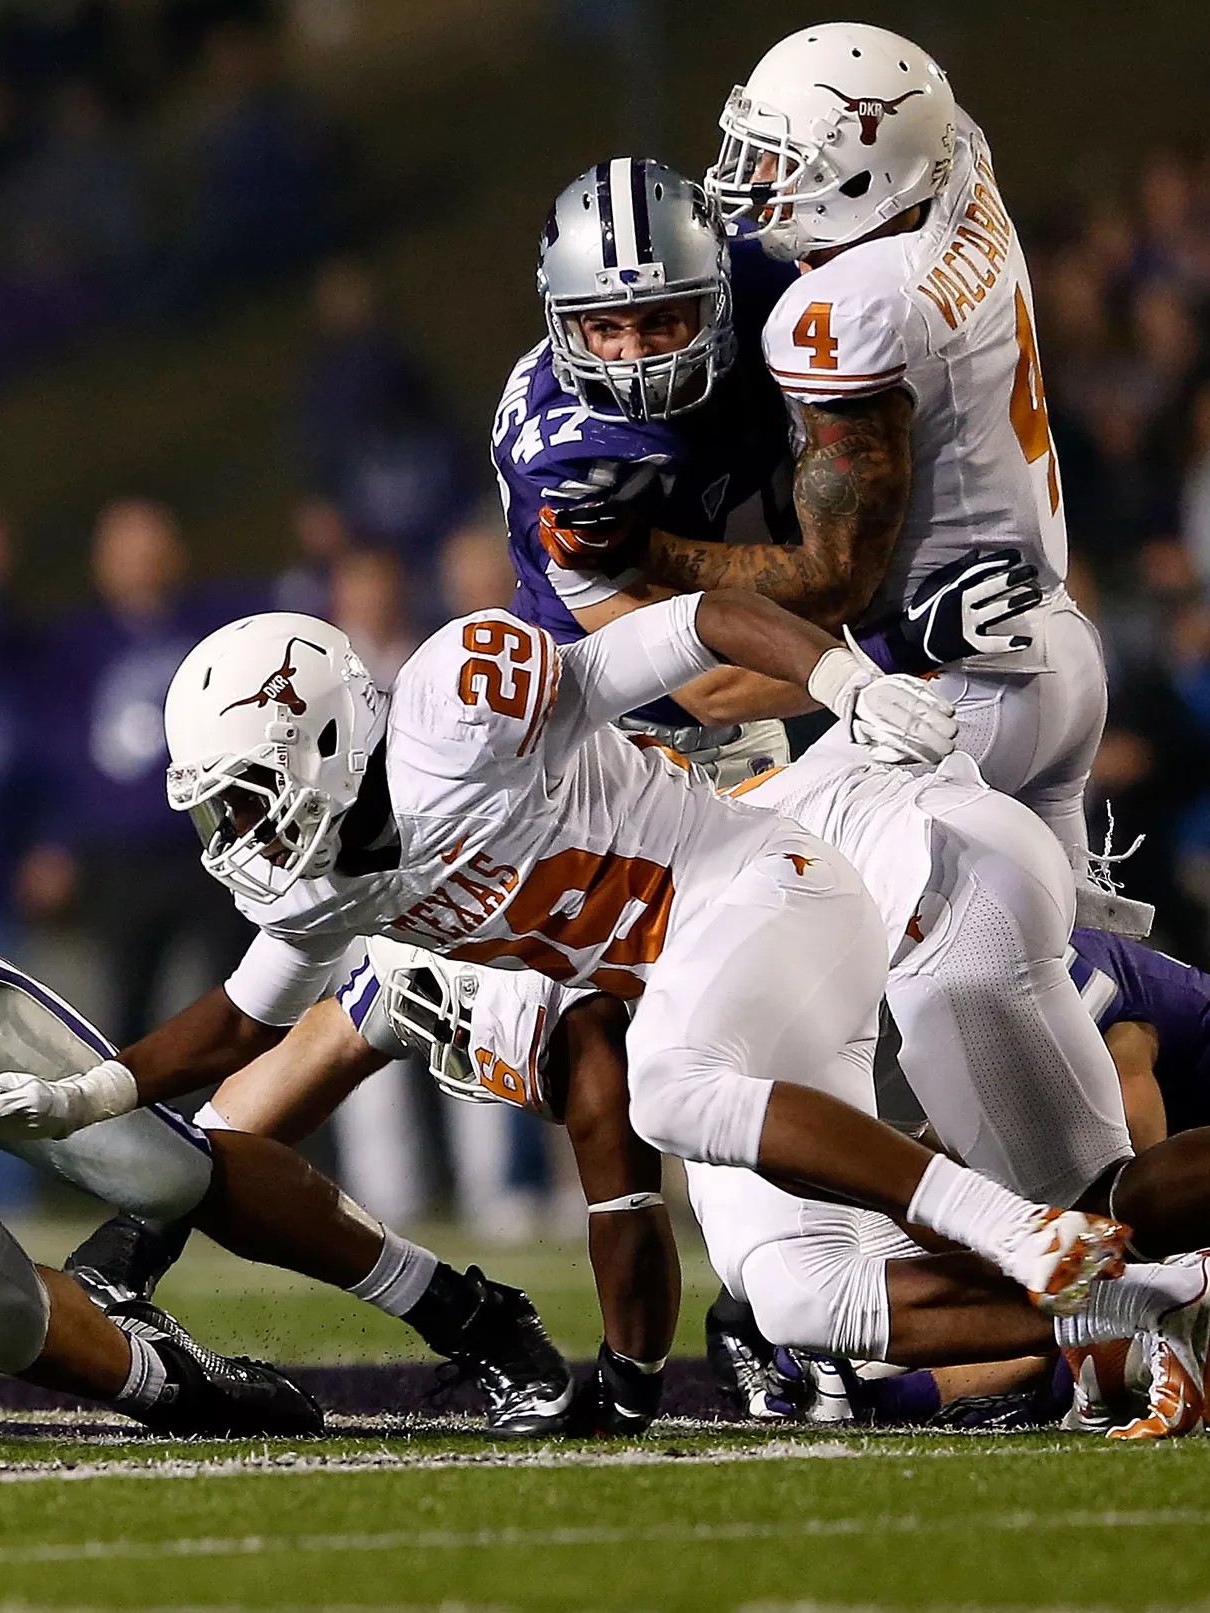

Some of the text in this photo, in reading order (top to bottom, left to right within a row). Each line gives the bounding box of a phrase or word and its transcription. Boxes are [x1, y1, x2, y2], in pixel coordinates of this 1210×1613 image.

[859, 102, 883, 117] DKR
[917, 183, 1011, 330] VACCARO
[792, 301, 838, 370] 4
[511, 404, 590, 465] 47
[262, 674, 289, 699] DKR
[458, 620, 532, 720] 29
[391, 850, 519, 946] TEXAS
